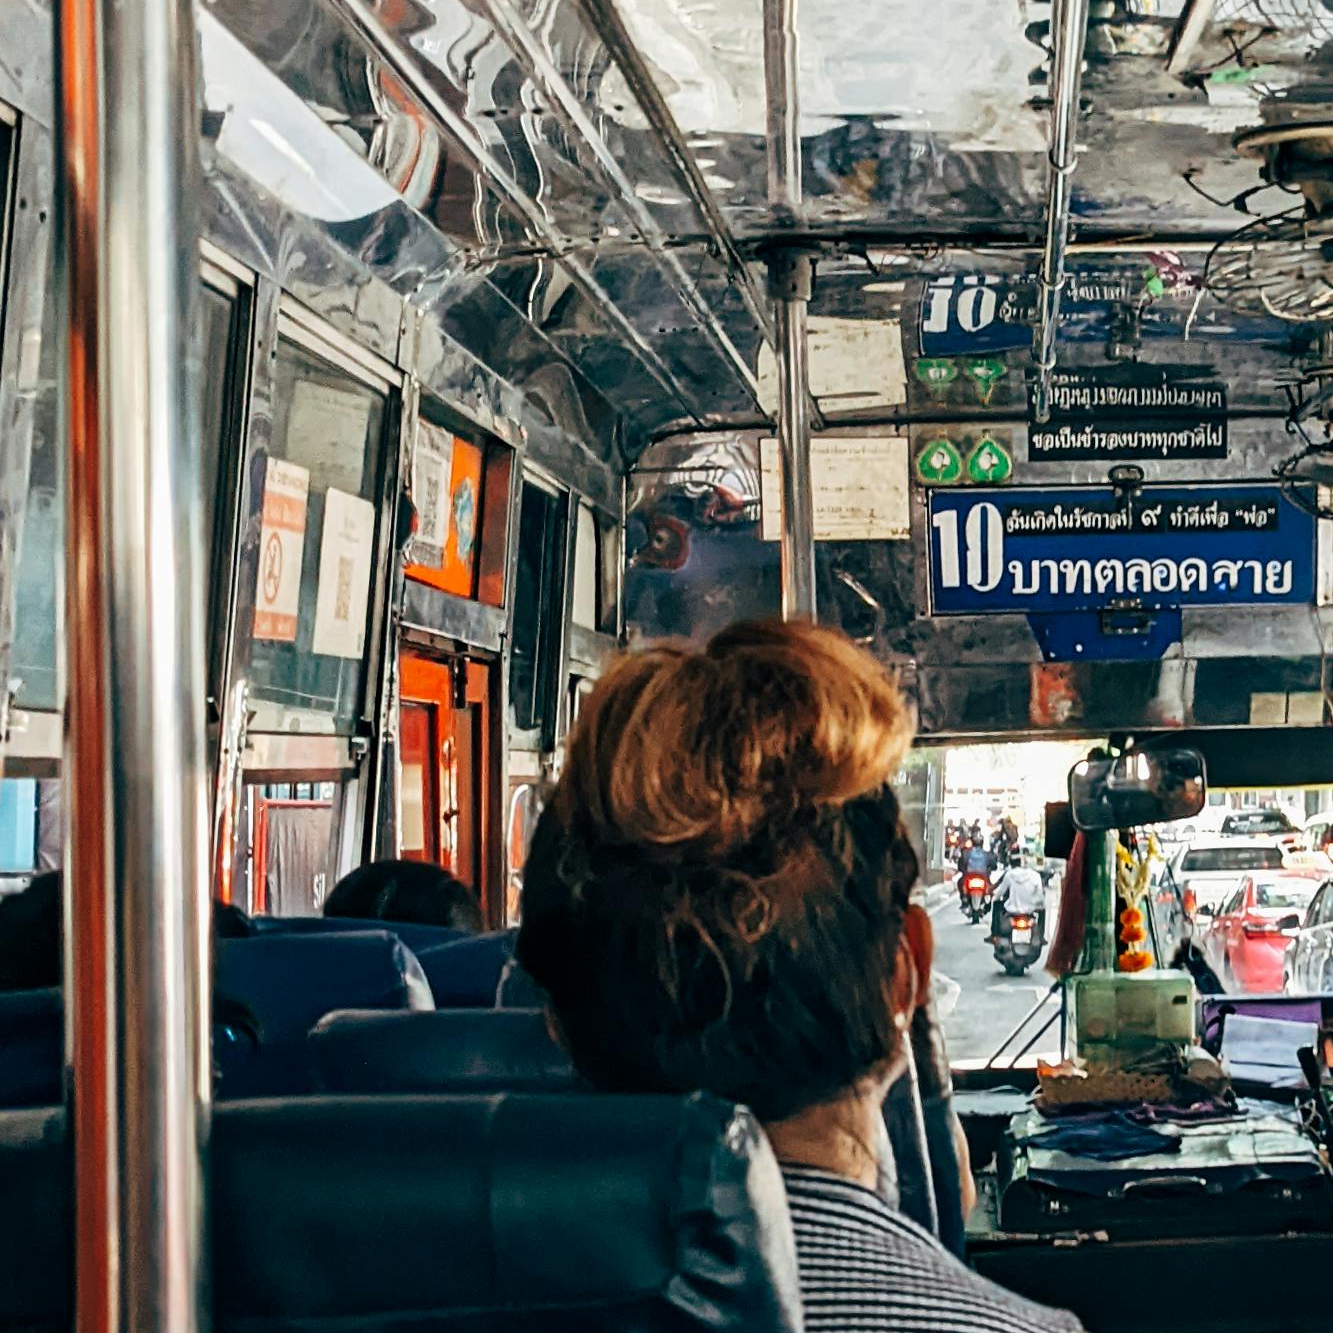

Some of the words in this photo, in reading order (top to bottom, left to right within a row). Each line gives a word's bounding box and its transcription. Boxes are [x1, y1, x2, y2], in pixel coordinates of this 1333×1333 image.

[1032, 423, 1223, 456] ขอเป็นข้ารองบาททุกชาติไป
[932, 502, 1004, 593] 10
[1008, 557, 1293, 595] บาทตลอดสาย
